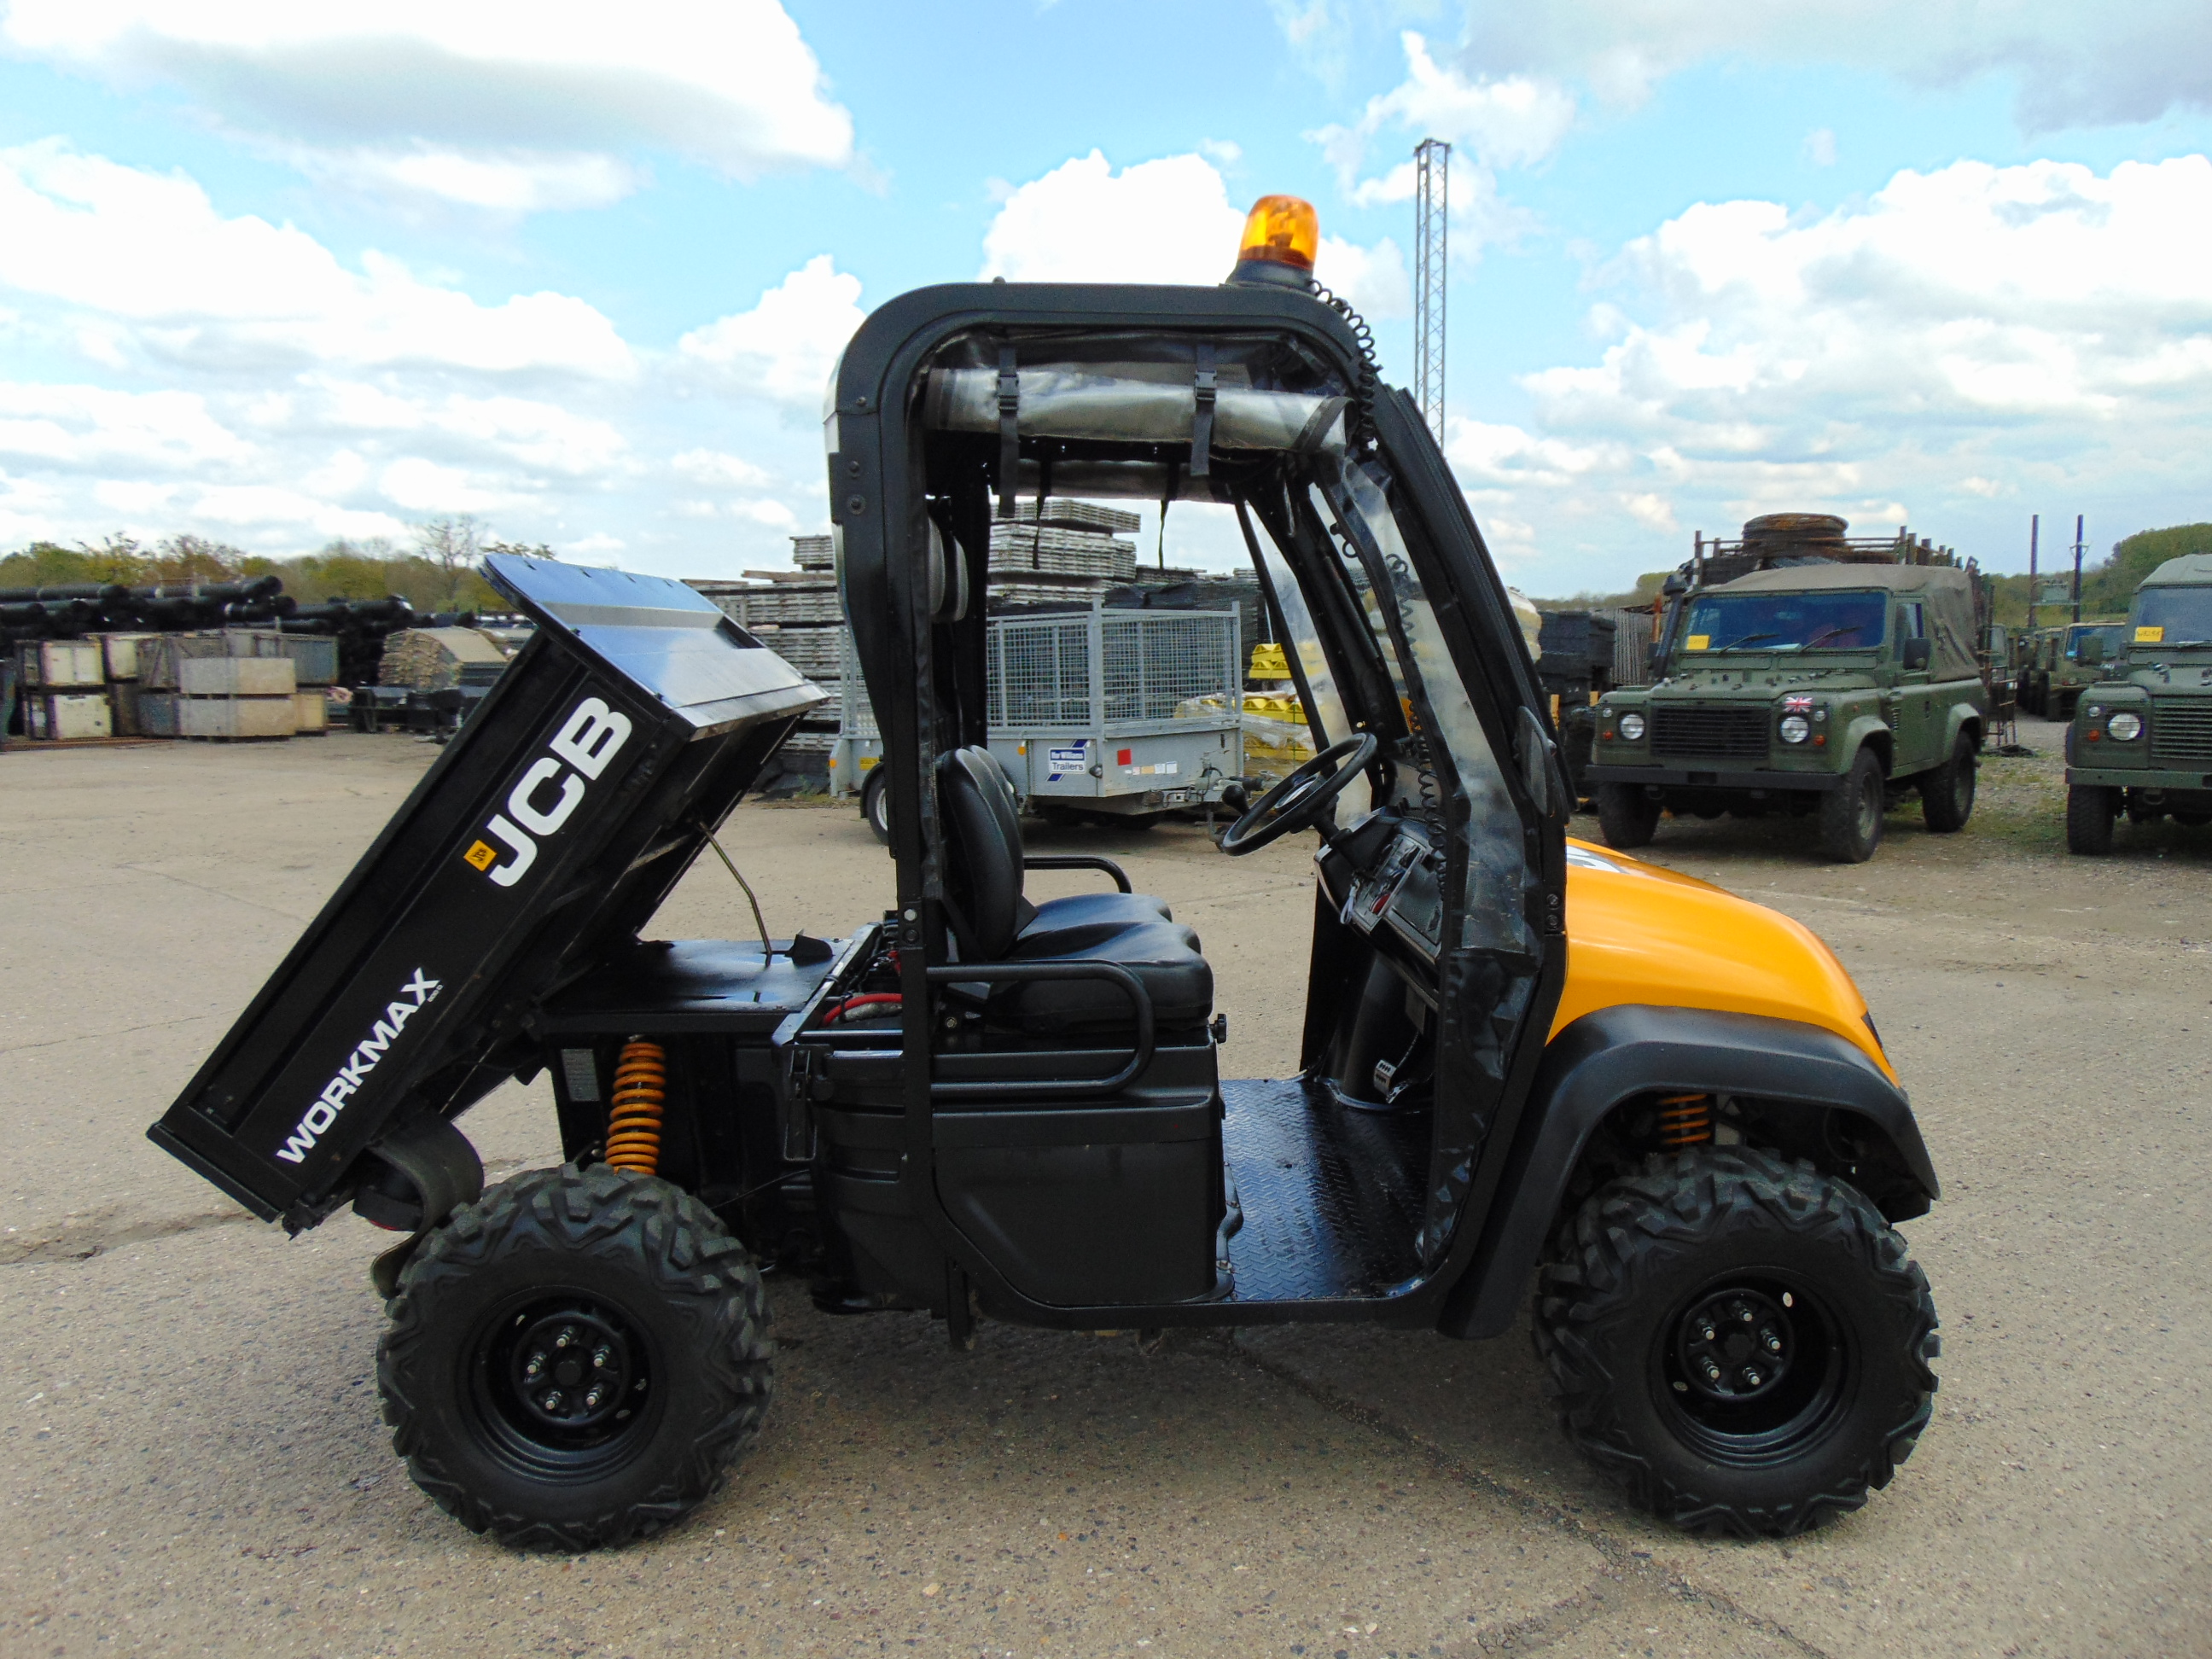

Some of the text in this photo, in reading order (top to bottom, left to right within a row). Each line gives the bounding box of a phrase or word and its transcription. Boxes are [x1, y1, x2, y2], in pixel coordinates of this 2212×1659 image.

[486, 696, 632, 888] JCB
[1052, 762, 1084, 771] Trailers
[276, 966, 440, 1164] WORKMAX
